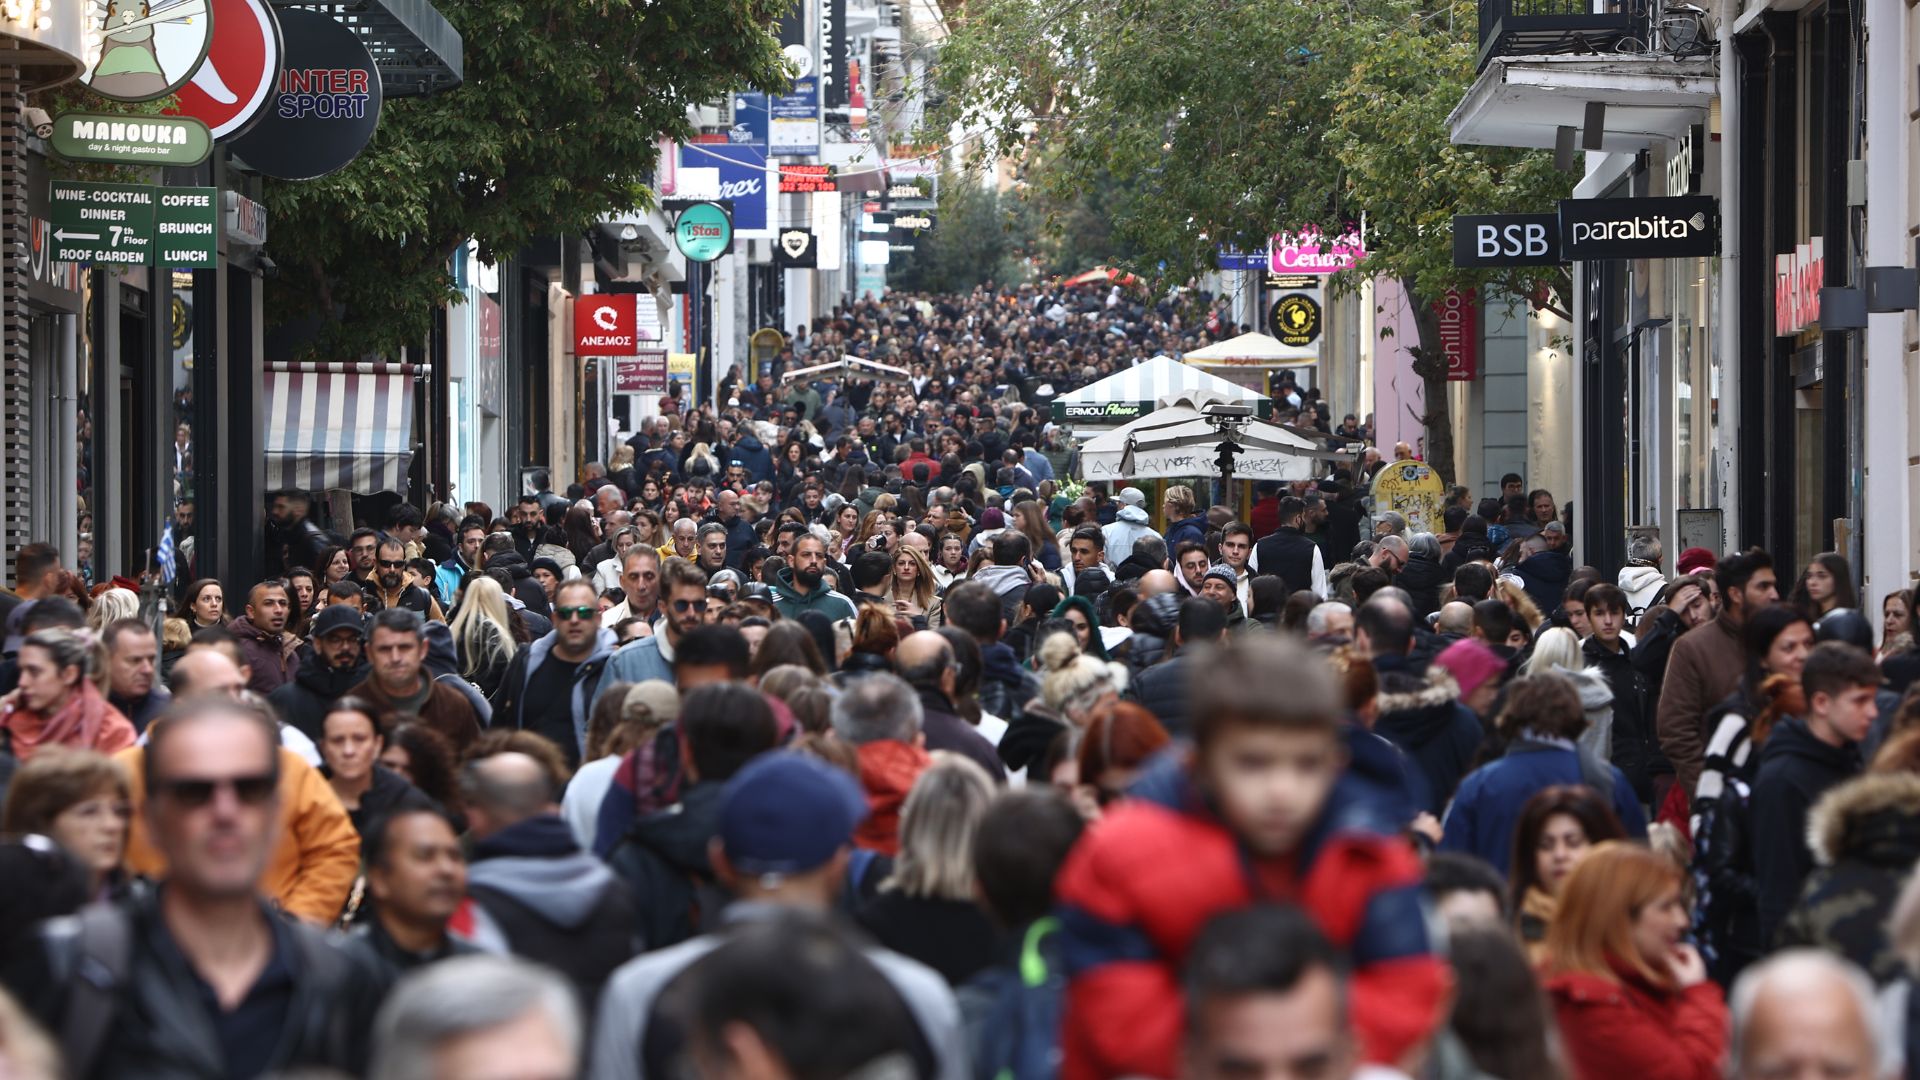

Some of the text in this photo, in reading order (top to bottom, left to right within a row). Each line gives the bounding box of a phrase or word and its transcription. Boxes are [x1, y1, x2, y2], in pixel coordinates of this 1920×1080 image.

[820, 0, 833, 85] SEPHOR
[279, 69, 369, 94] INTER
[278, 94, 369, 119] SPORT
[72, 120, 187, 145] MANOUKA
[88, 143, 103, 153] day
[111, 144, 131, 154] night
[131, 146, 156, 155] gastro
[156, 146, 171, 154] bar
[161, 195, 210, 207] COFFEE
[80, 208, 126, 221] DINNER
[159, 222, 212, 234] BRUNCH
[1572, 215, 1688, 245] parabita
[123, 236, 149, 245] Floor
[1477, 224, 1549, 258] BSB
[59, 249, 144, 263] ROOF GARDEN
[164, 250, 208, 262] LUNCH
[1440, 281, 1461, 368] chillbox
[580, 336, 632, 346] ΑΝΕΜΟΣ
[1065, 407, 1105, 416] ERMOU
